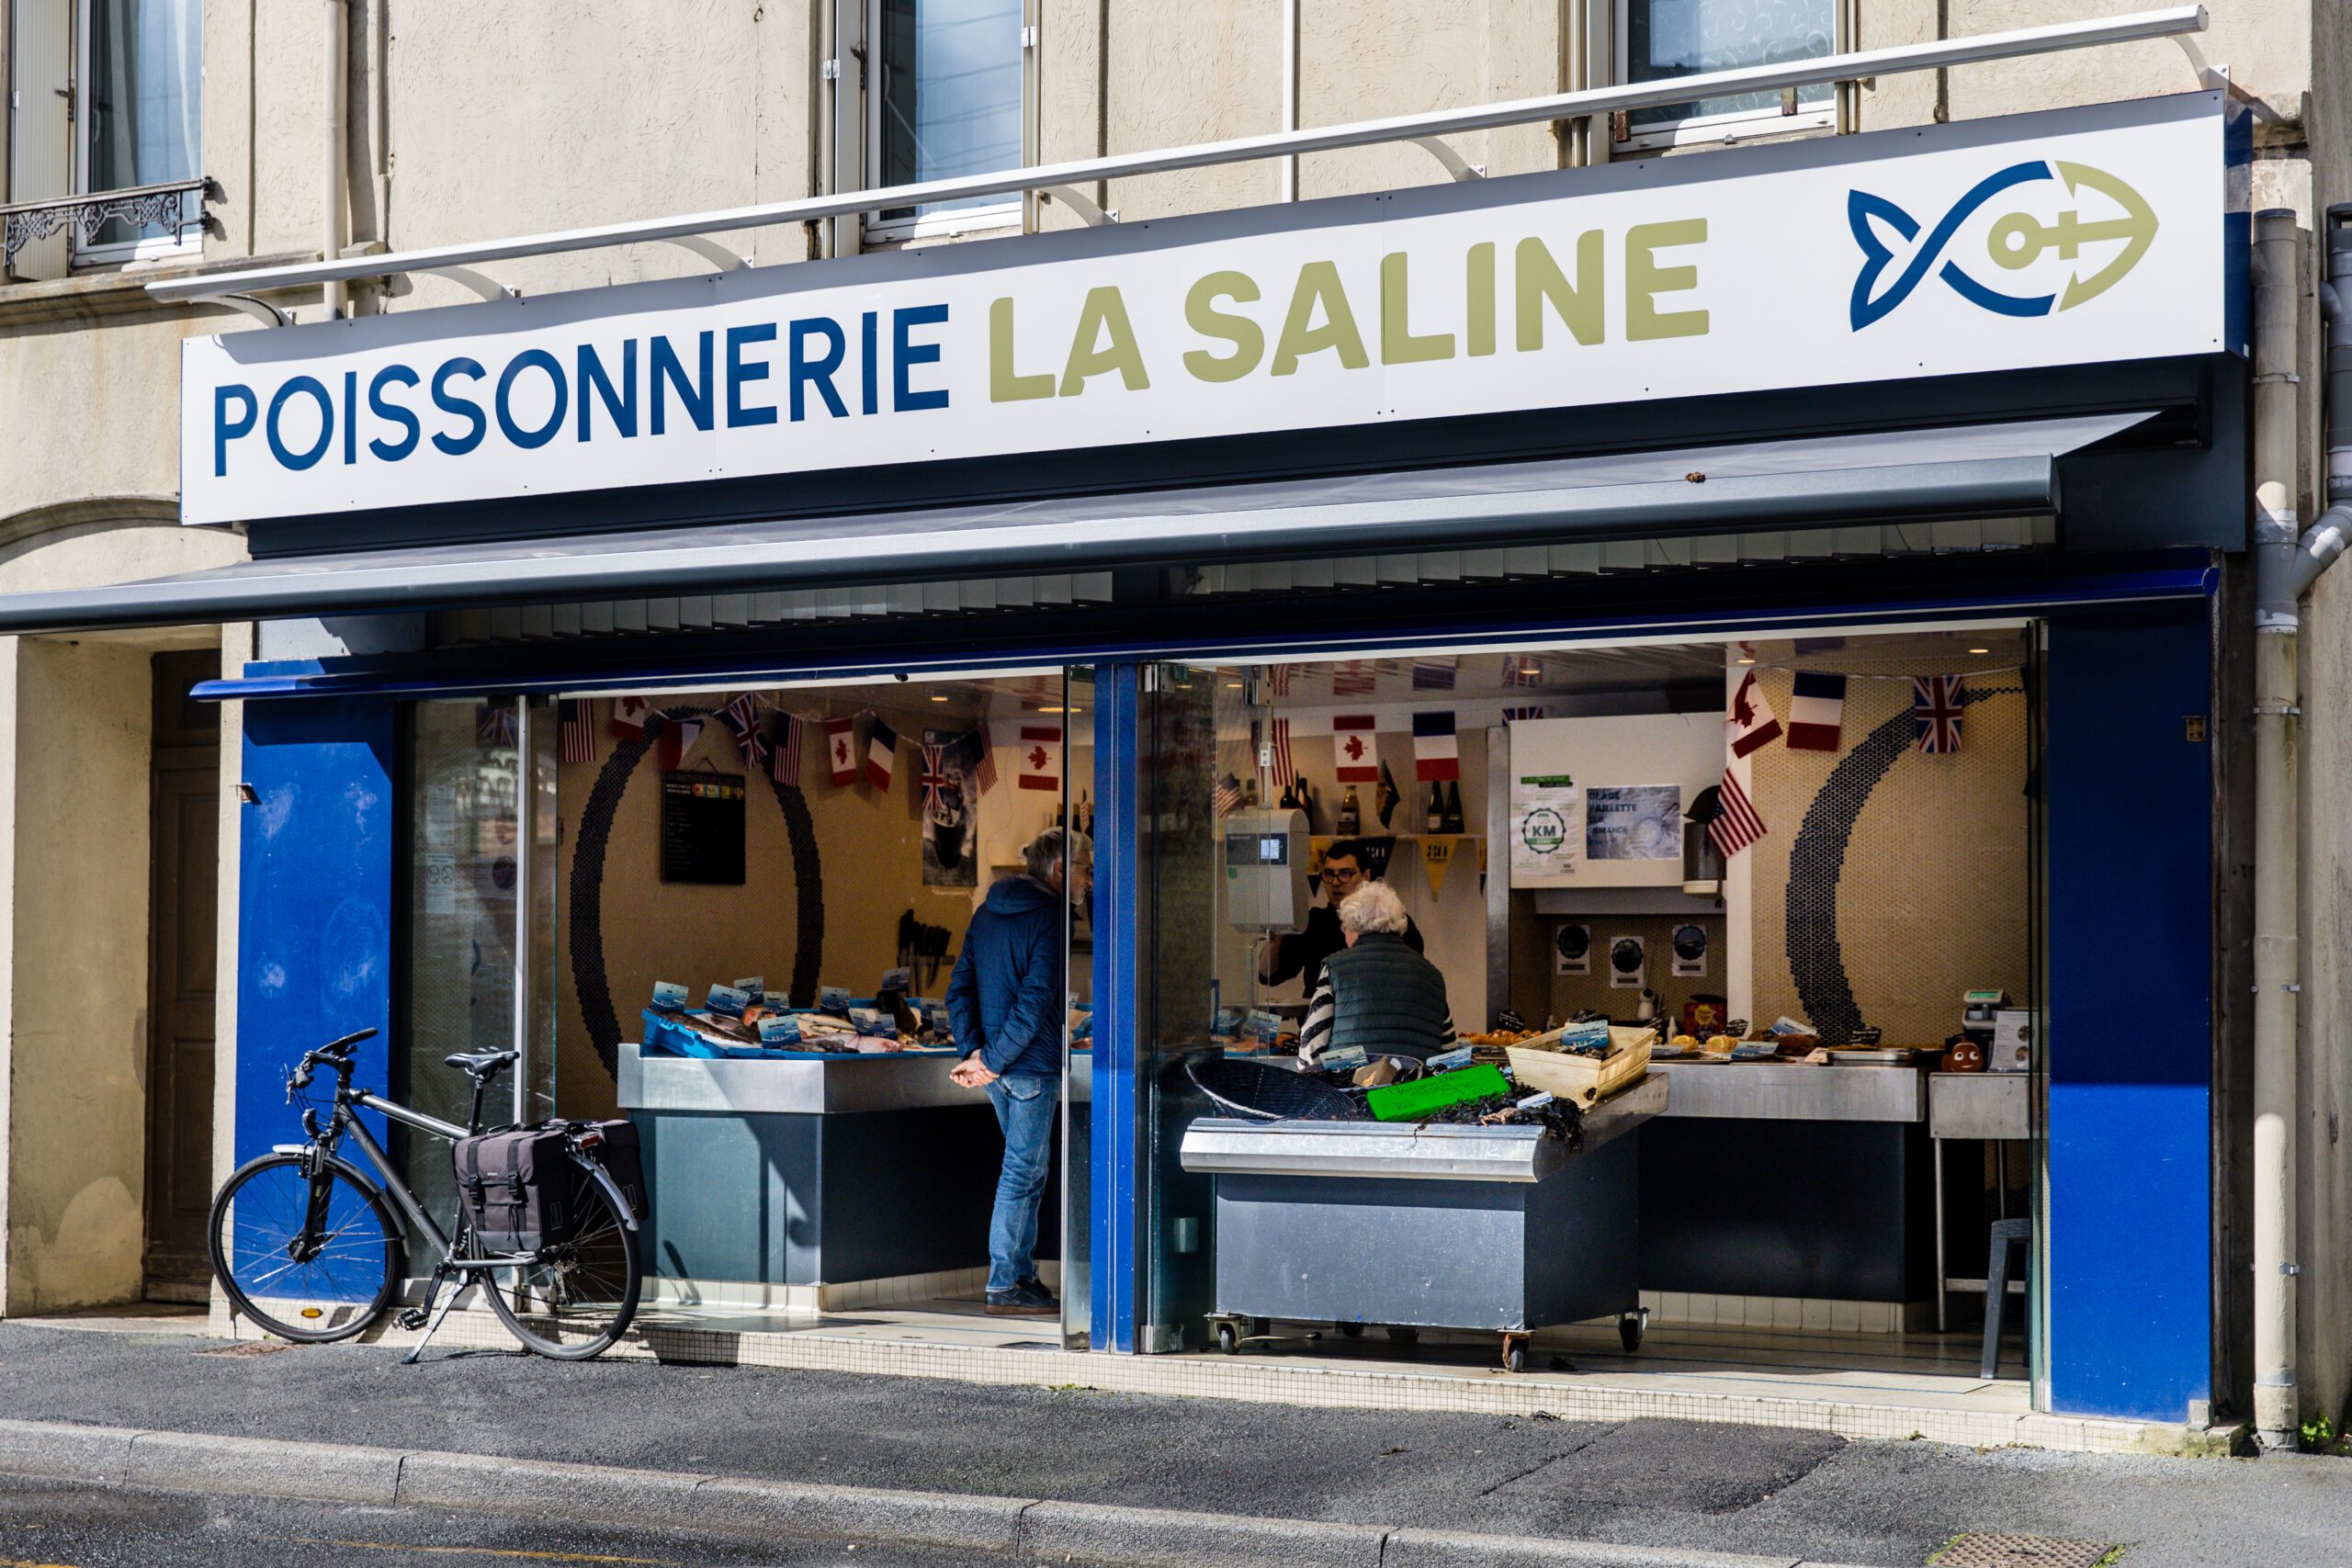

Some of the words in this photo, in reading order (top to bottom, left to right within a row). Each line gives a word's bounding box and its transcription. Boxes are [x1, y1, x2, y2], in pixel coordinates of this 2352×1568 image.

[214, 303, 950, 478] POISSONNERIE
[989, 287, 1150, 402] LA
[1184, 219, 1709, 383] SALINE
[1589, 803, 1637, 813] PAILLETTE
[1532, 825, 1556, 838] KM
